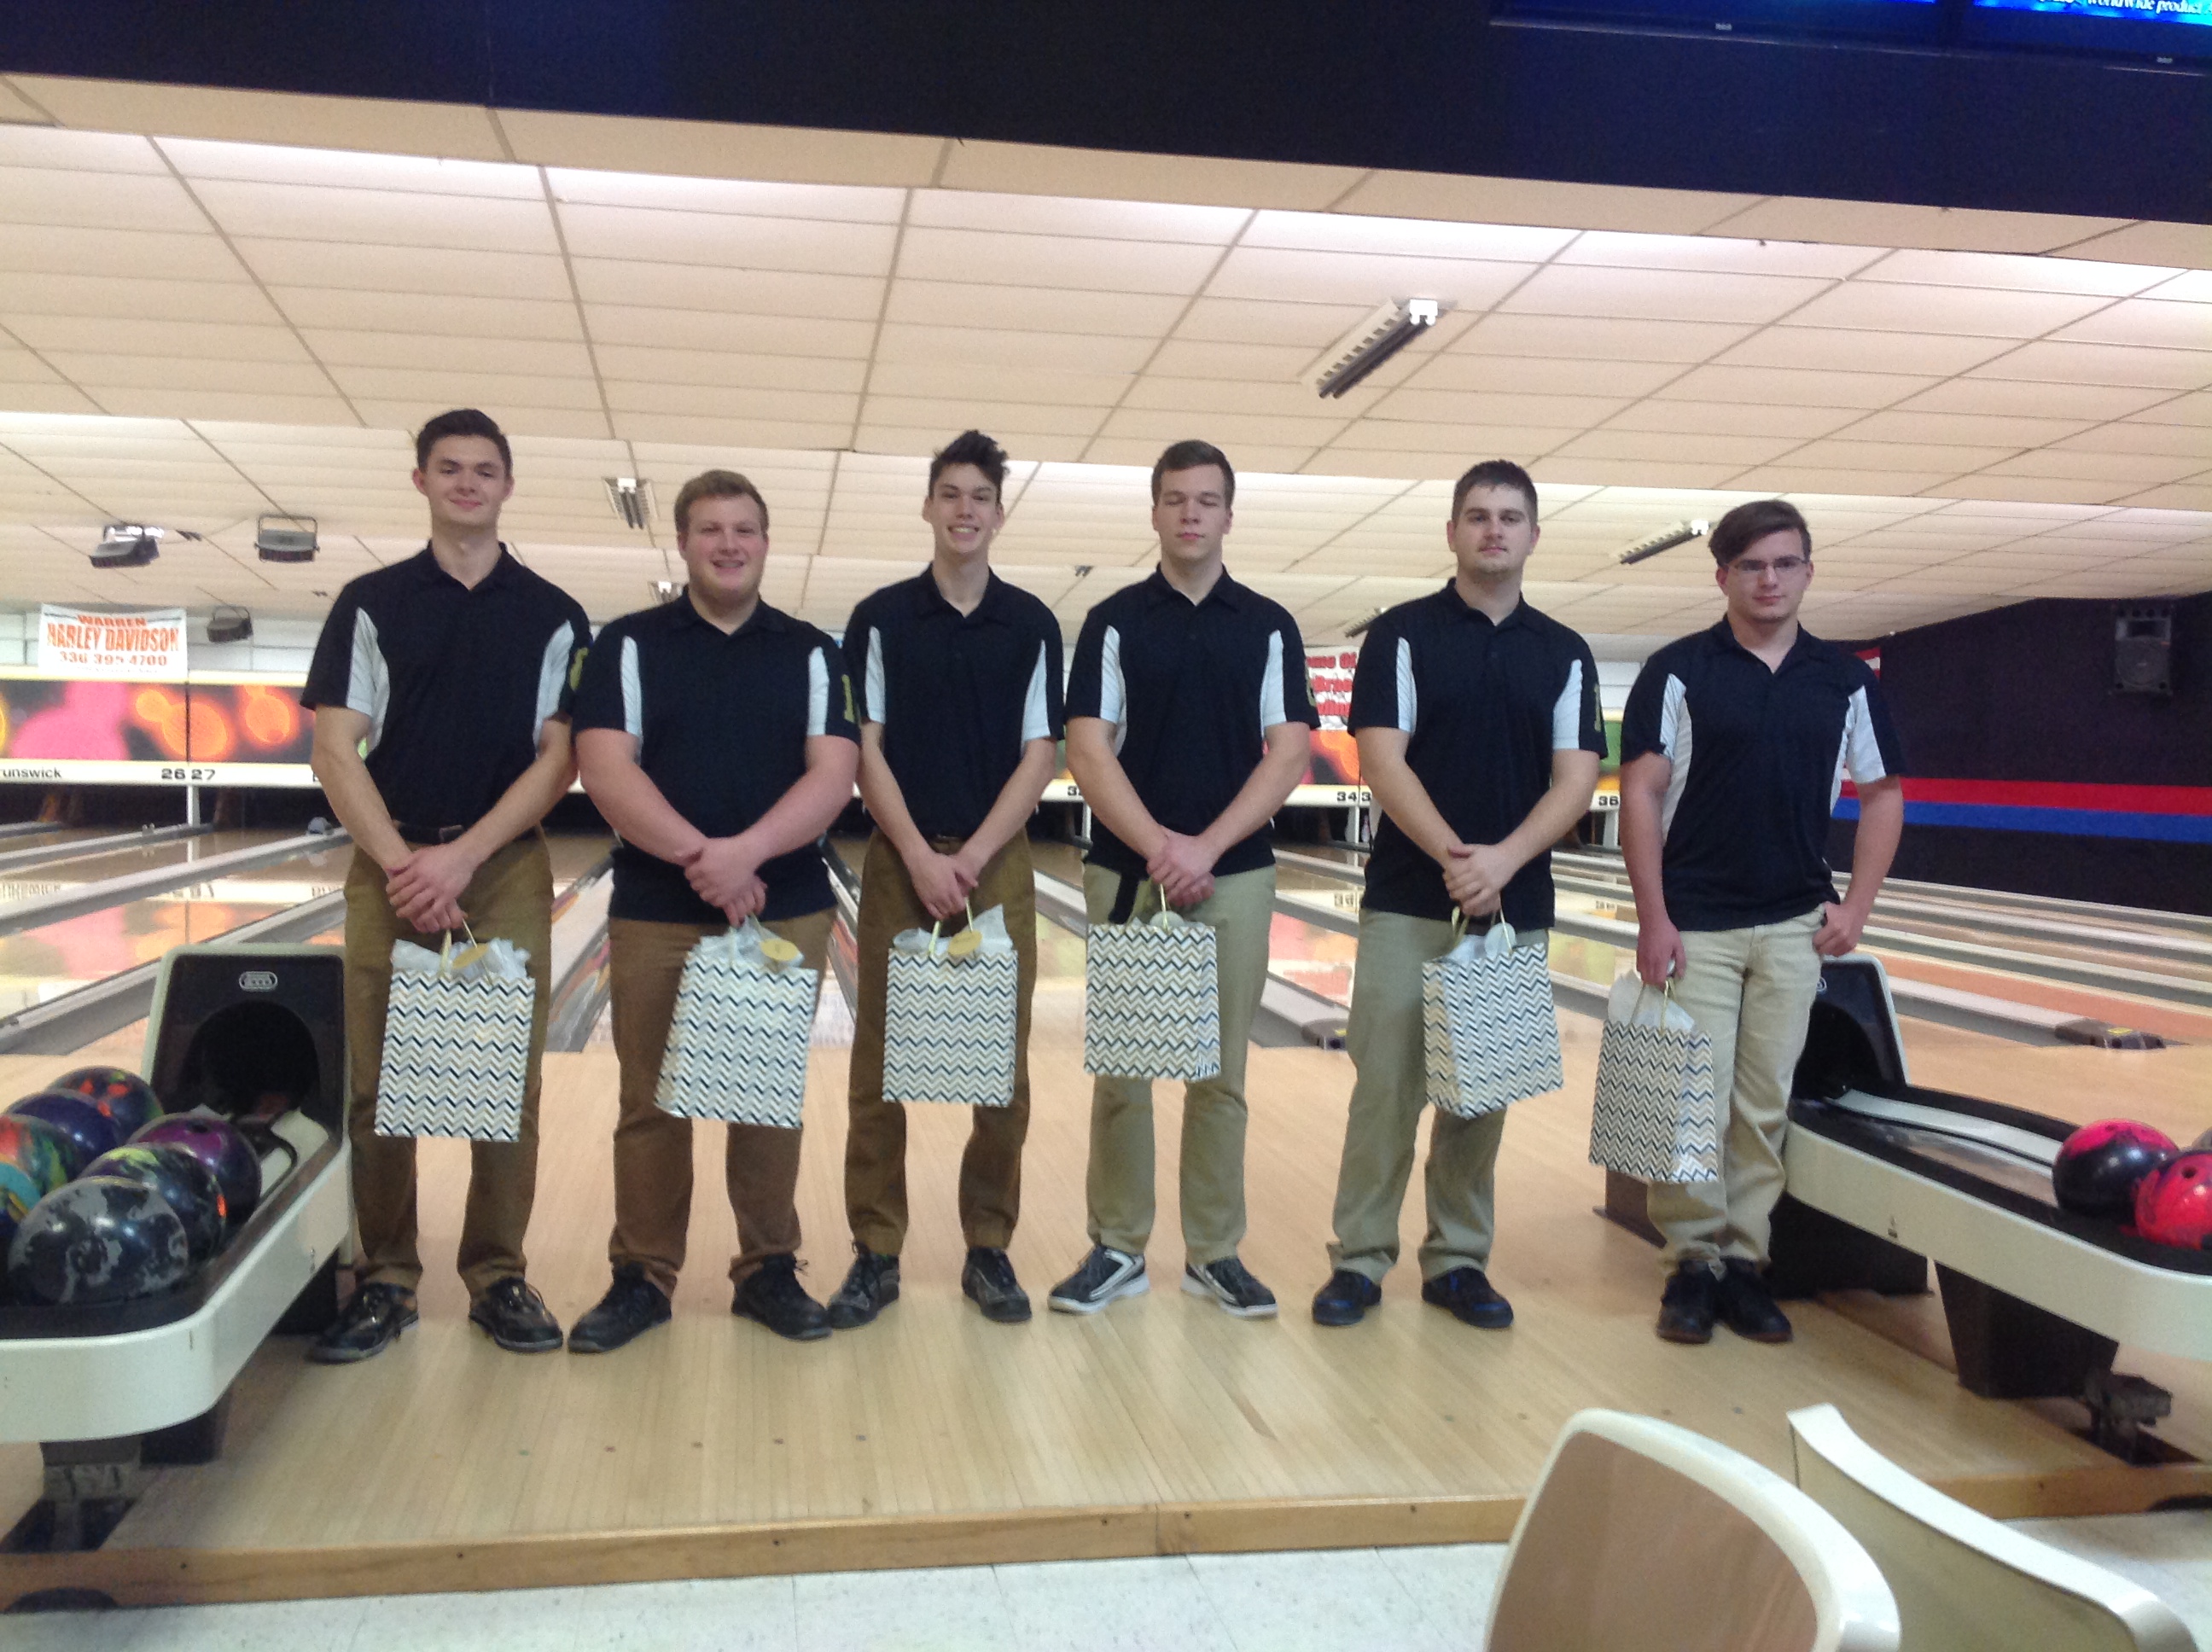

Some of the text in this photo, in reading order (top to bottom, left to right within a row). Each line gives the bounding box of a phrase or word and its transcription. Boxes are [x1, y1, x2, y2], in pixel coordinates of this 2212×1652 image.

[77, 614, 147, 627] WARREN
[47, 623, 179, 652] HARLEY DAVIDSON
[129, 654, 167, 666] 4700
[0, 766, 216, 781] unswick 26 27
[1336, 791, 1358, 802] 34
